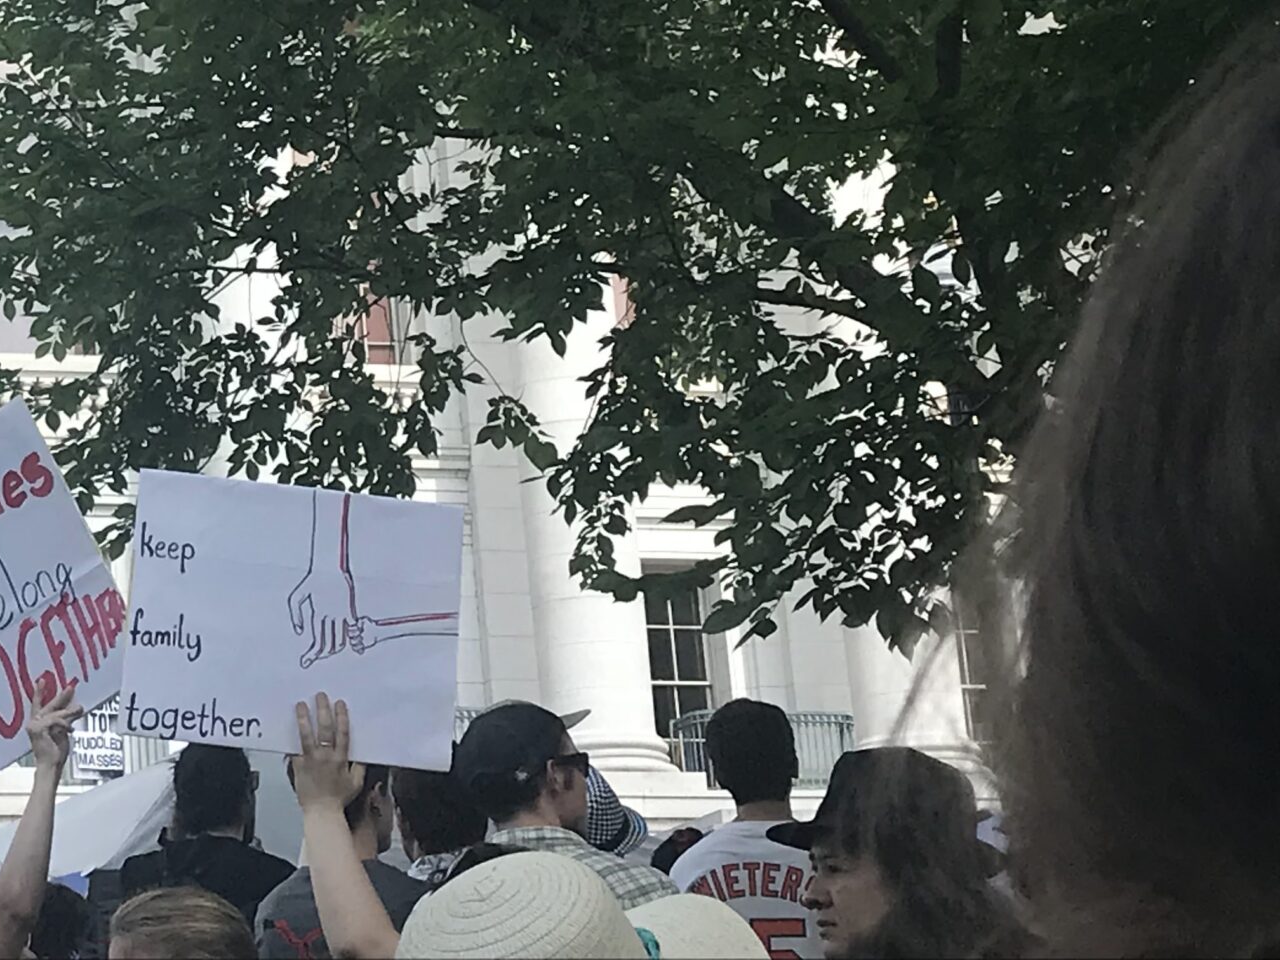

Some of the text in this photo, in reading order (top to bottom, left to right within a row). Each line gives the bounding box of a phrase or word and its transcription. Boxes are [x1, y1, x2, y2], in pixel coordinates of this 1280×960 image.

[139, 521, 196, 574] keep
[130, 608, 202, 662] family
[90, 712, 107, 733] TO
[124, 692, 263, 741] together.
[78, 753, 122, 768] MASSES
[687, 861, 815, 902] WIETER
